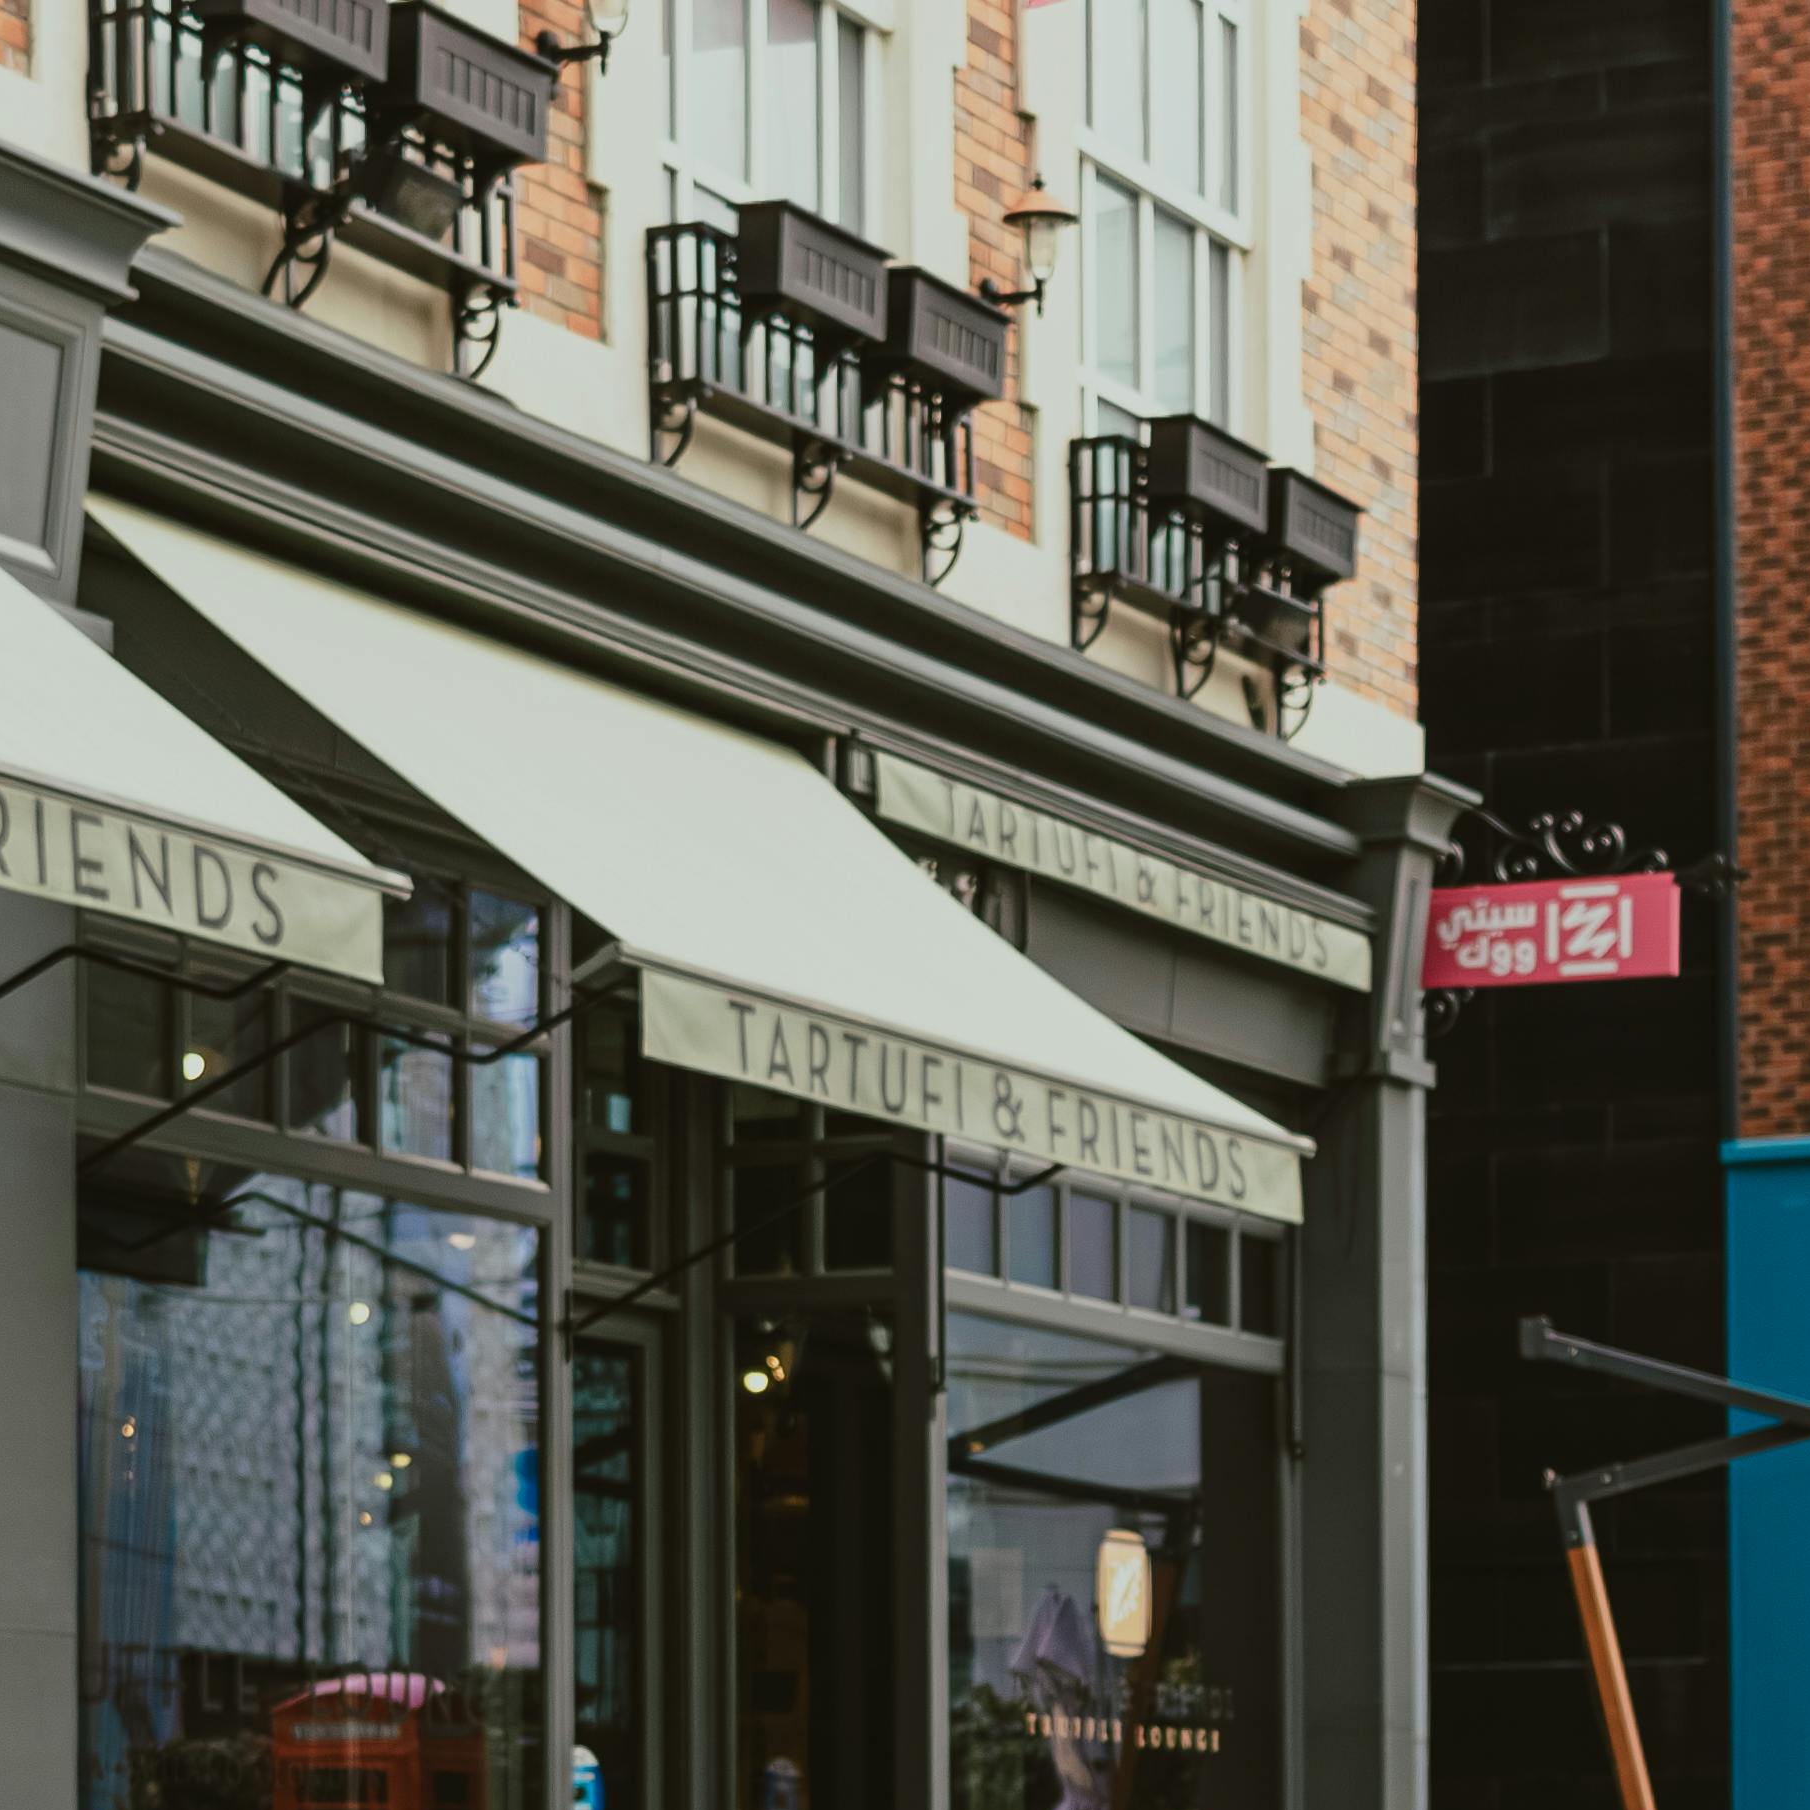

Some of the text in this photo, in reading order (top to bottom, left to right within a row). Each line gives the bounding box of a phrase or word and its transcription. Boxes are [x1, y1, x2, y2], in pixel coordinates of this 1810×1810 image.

[1436, 896, 1537, 950] سيتي
[728, 999, 1246, 1201] TARTUFI & FRIENDS
